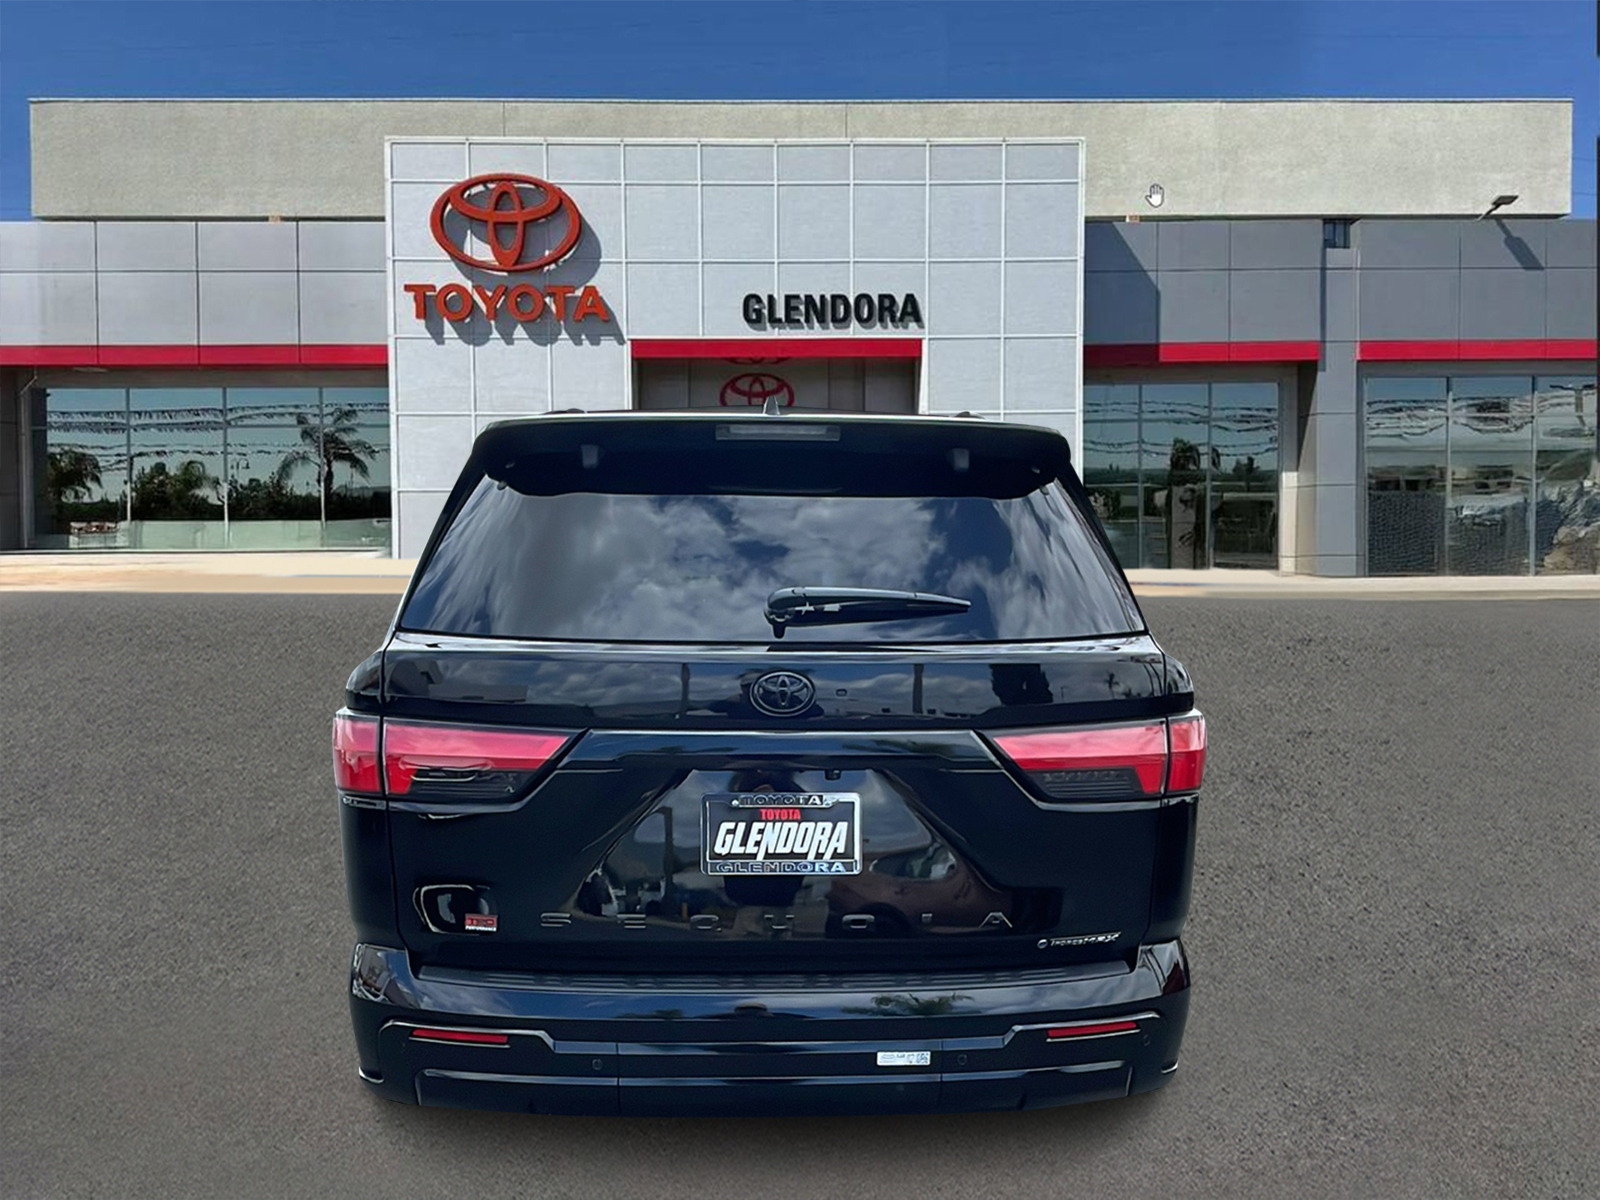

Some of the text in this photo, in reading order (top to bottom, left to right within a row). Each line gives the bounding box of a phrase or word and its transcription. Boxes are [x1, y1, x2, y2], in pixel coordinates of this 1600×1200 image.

[404, 284, 610, 323] TOYOTA
[743, 294, 922, 324] GLENDORA
[740, 794, 822, 805] TOYOTA
[760, 808, 801, 820] TOYOTA
[714, 822, 848, 861] GLENDORA
[716, 862, 846, 873] GLENDORA
